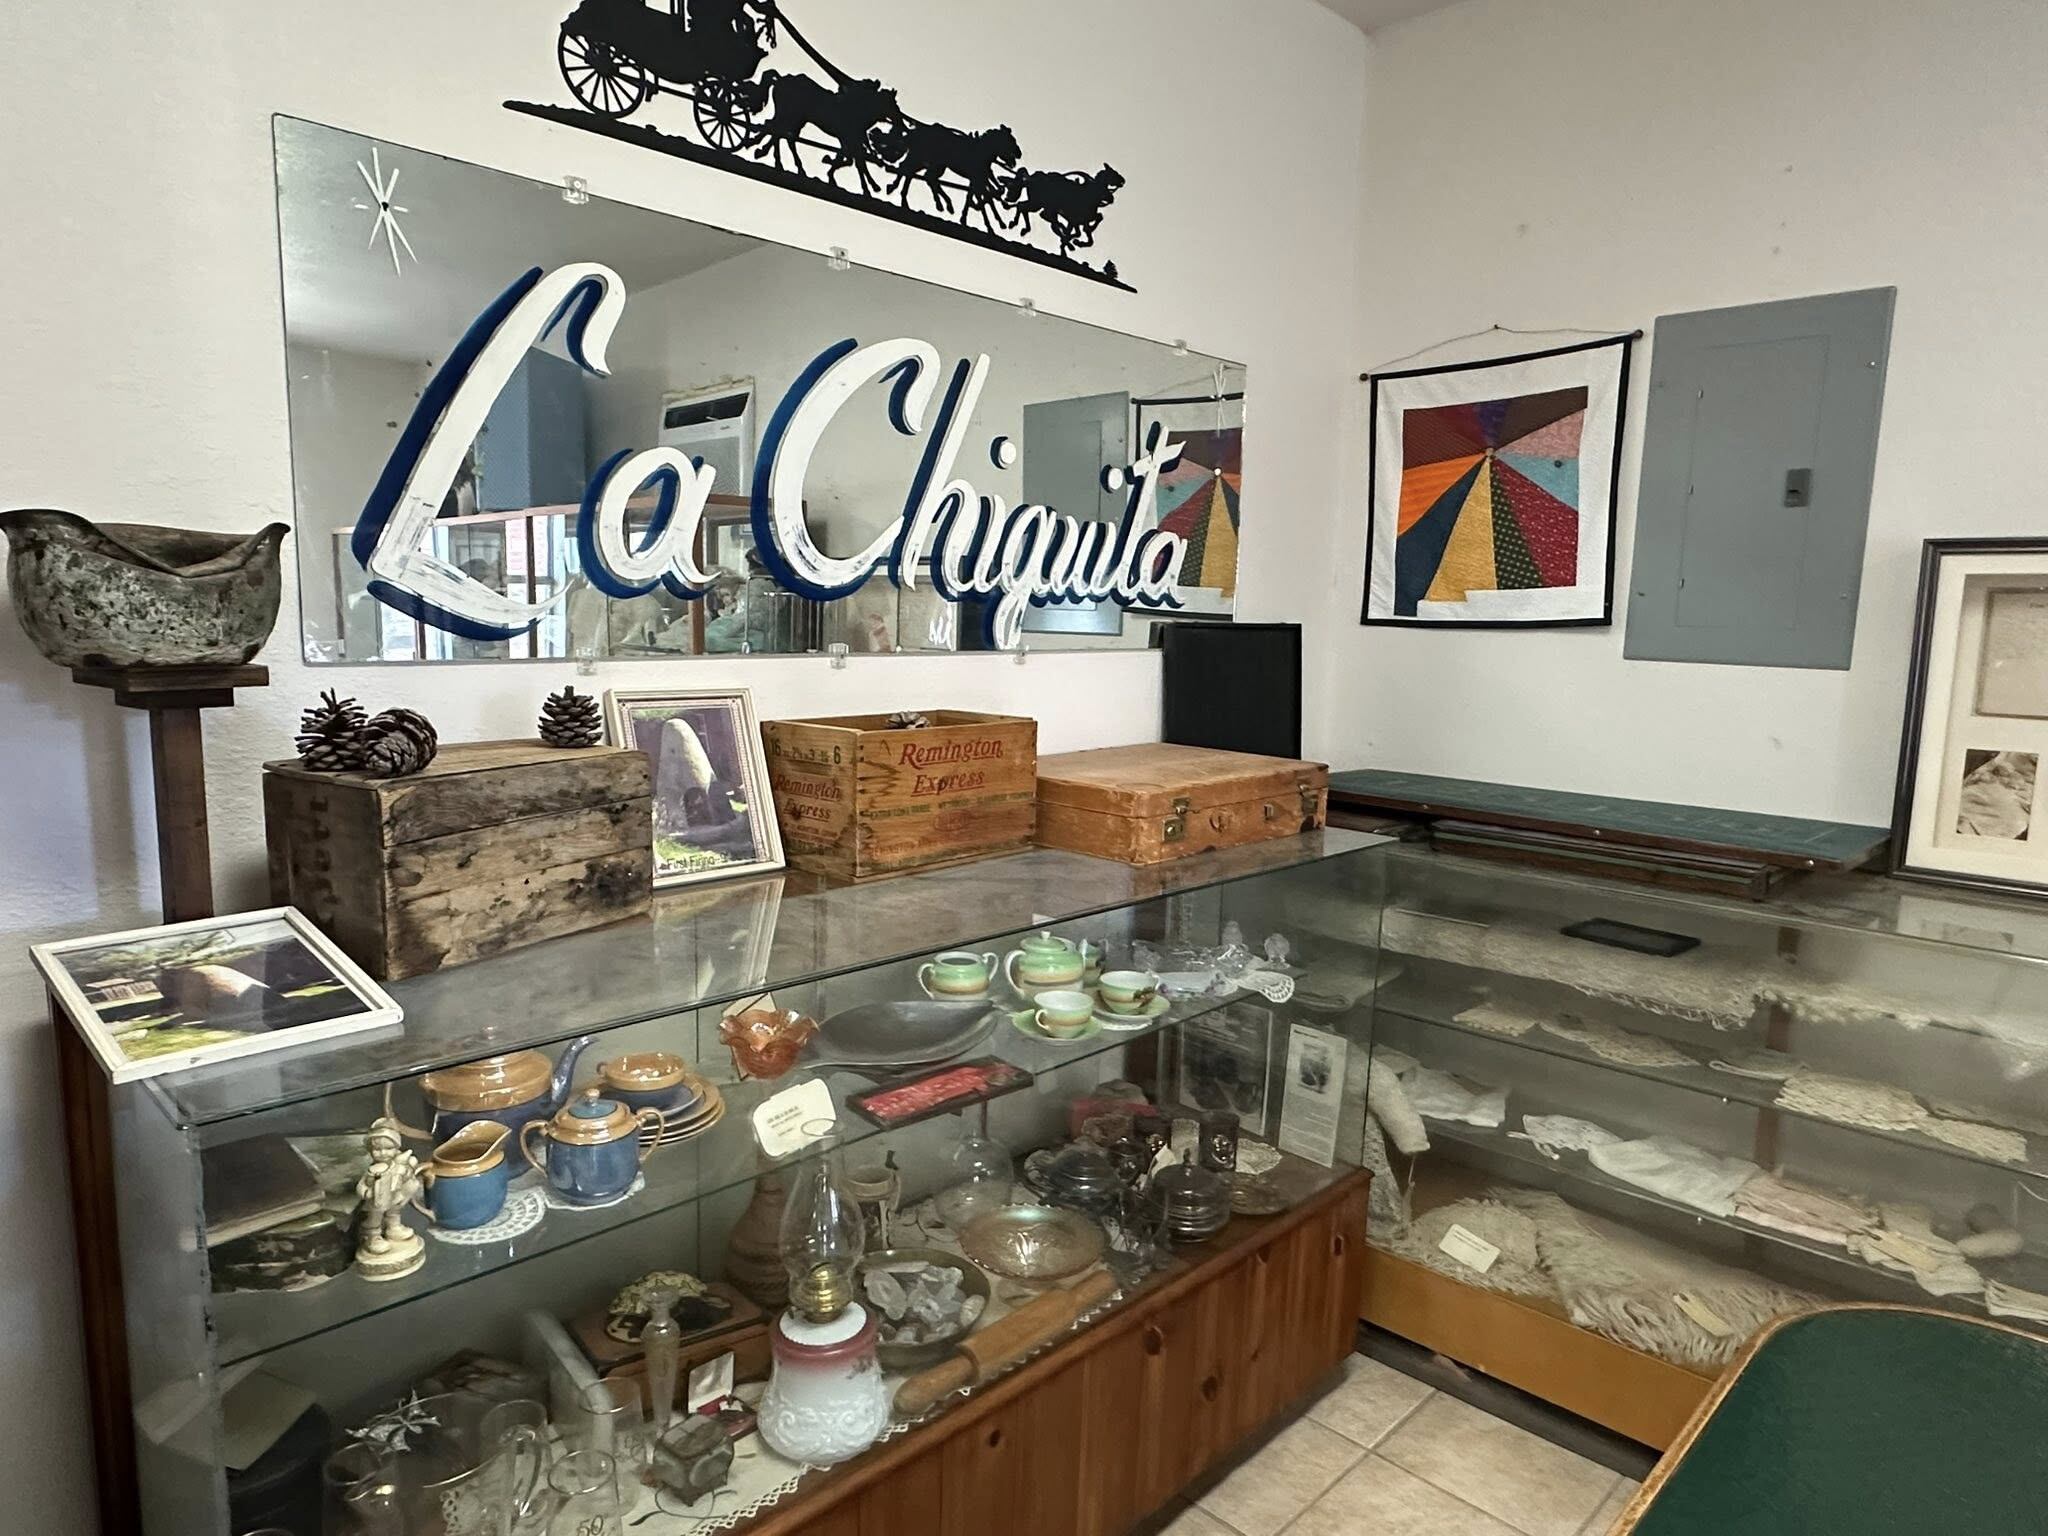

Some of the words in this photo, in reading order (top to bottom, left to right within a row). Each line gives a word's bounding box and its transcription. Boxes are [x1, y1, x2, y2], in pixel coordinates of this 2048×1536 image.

[353, 261, 722, 641] La
[751, 336, 1192, 652] Chiquita
[898, 737, 1004, 770] Remington
[775, 774, 842, 801] Remington
[911, 769, 986, 797] Express
[783, 798, 832, 823] Express
